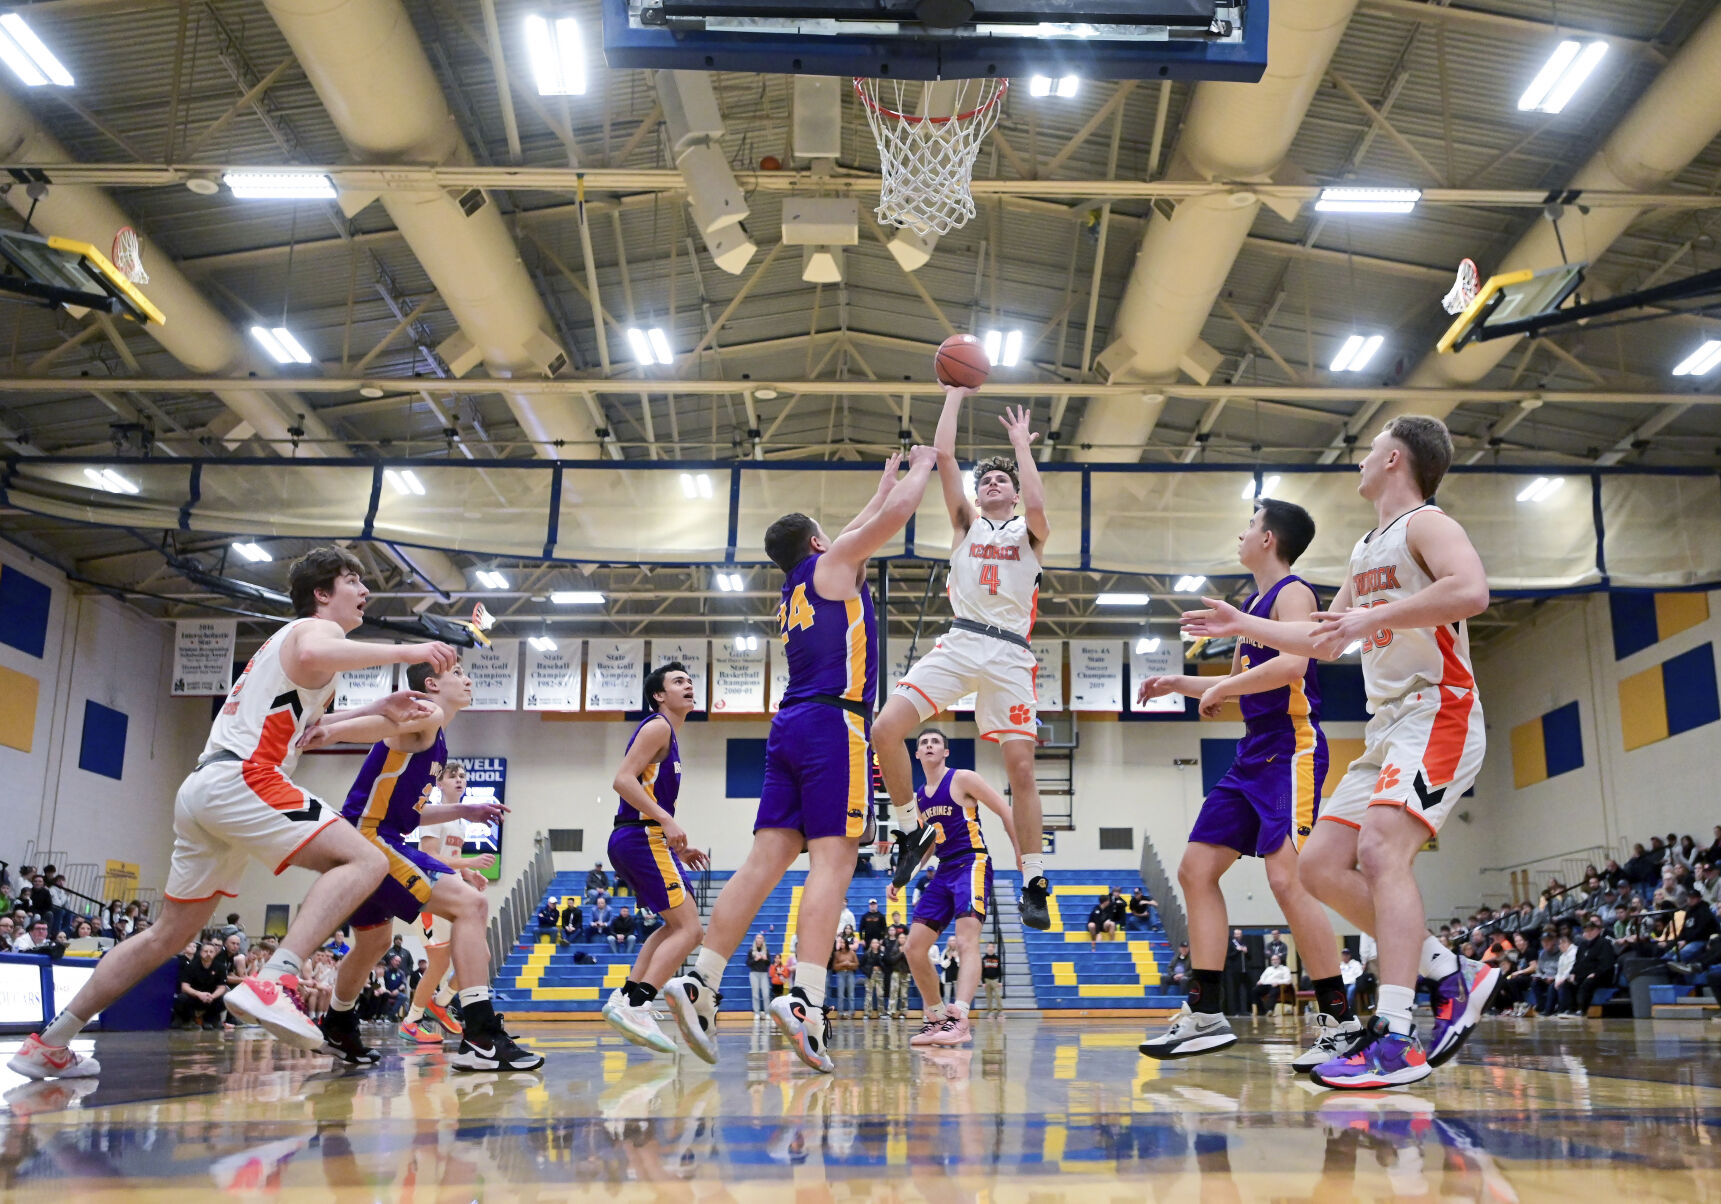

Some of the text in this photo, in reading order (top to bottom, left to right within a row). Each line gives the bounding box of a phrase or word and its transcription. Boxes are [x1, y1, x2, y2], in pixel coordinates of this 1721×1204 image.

[979, 564, 1001, 595] 4
[472, 662, 508, 671] Boys Golf
[537, 662, 570, 670] Baseball
[597, 662, 634, 671] Boys Golf
[468, 672, 511, 680] Champions
[720, 671, 759, 679] Basketball
[1077, 672, 1116, 680] Champions
[447, 758, 504, 770] WELL
[465, 771, 503, 782] HOOL
